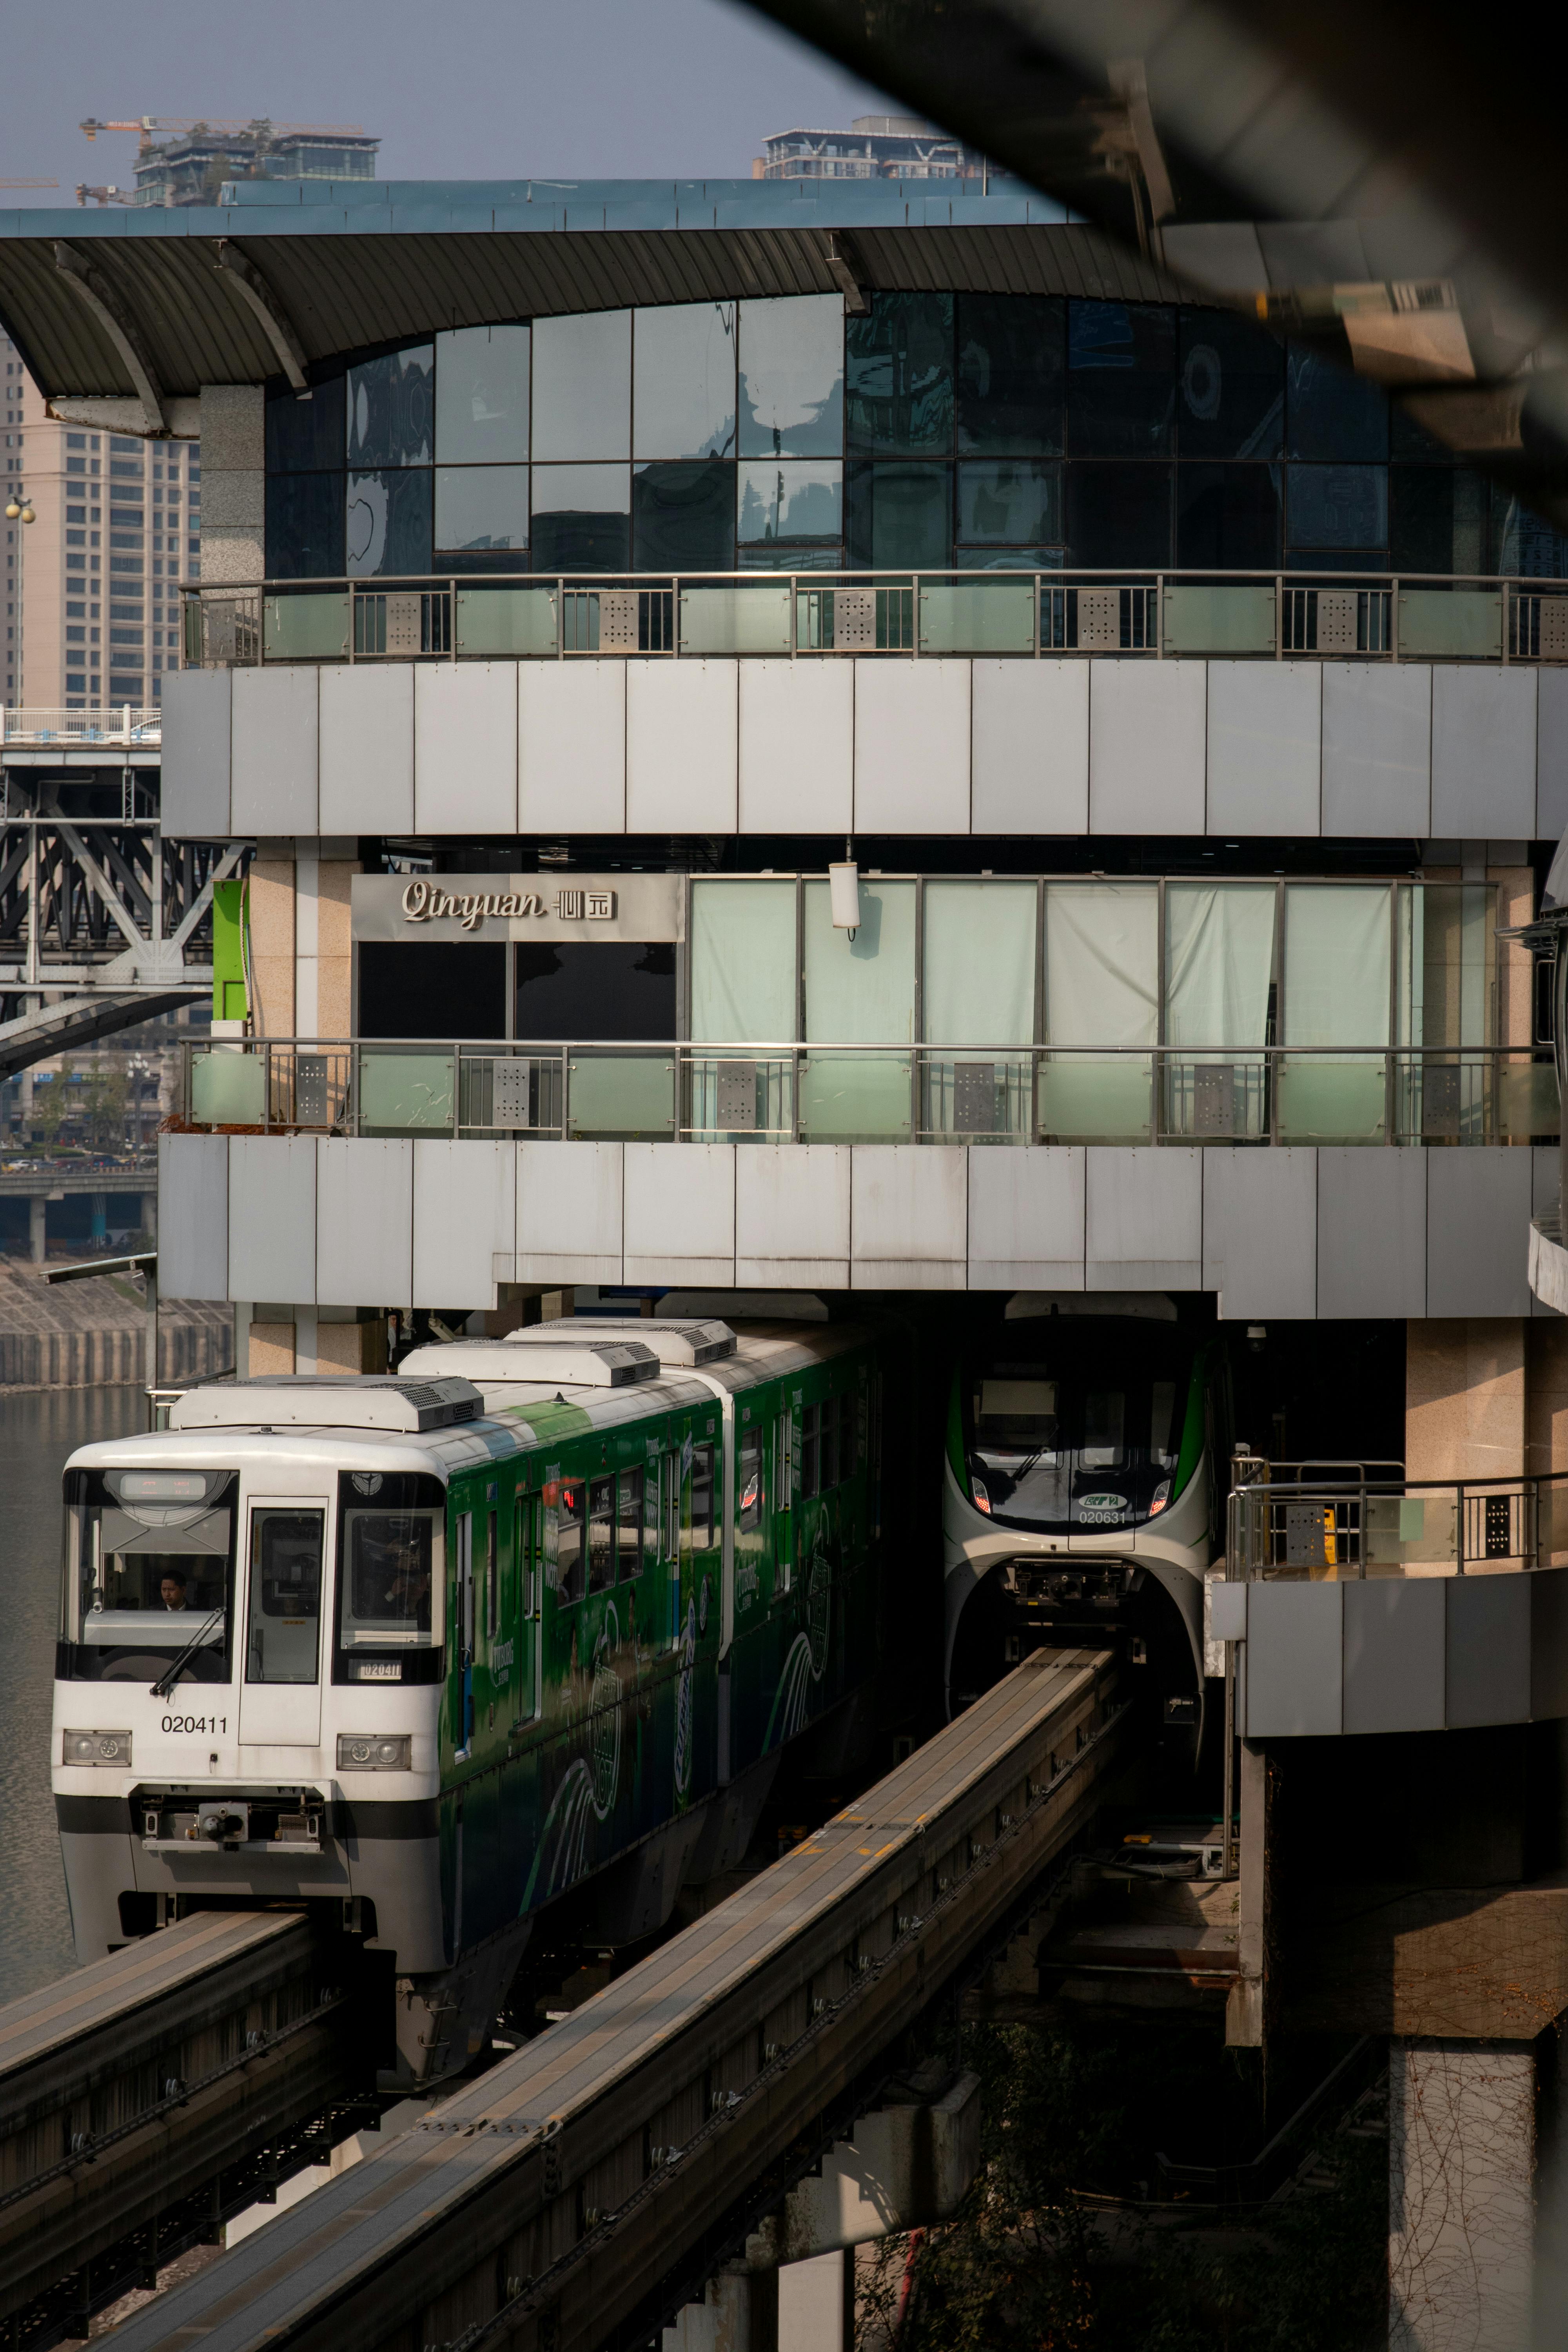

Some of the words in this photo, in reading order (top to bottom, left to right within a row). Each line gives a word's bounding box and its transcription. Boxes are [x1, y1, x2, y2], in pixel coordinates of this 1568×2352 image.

[402, 881, 548, 930] Qinyuan
[1080, 1512, 1125, 1524] 020631
[494, 1637, 514, 1674] TUBORG
[365, 1664, 399, 1676] 020411
[162, 1716, 226, 1733] 020411
